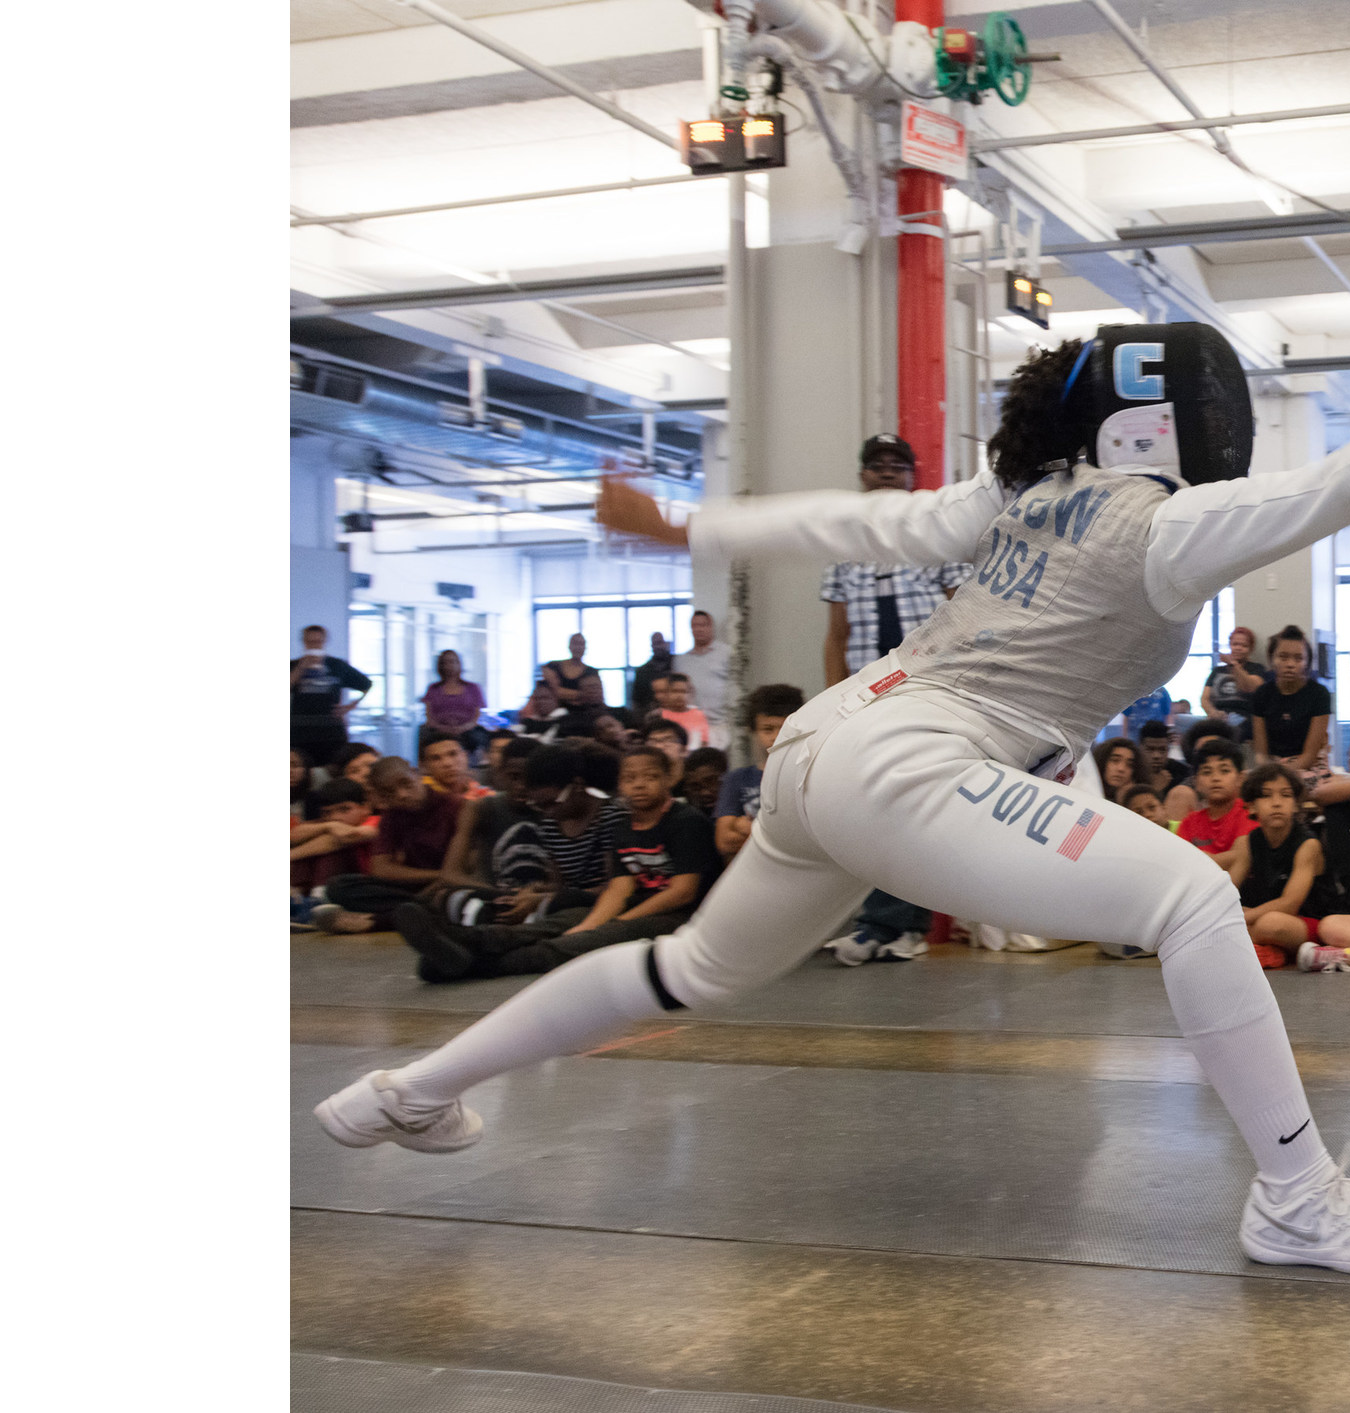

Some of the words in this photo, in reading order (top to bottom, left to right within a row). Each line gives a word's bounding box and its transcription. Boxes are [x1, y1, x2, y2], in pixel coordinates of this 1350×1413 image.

[1113, 342, 1166, 401] C
[977, 526, 1049, 609] USA
[957, 761, 1075, 846] DSC
